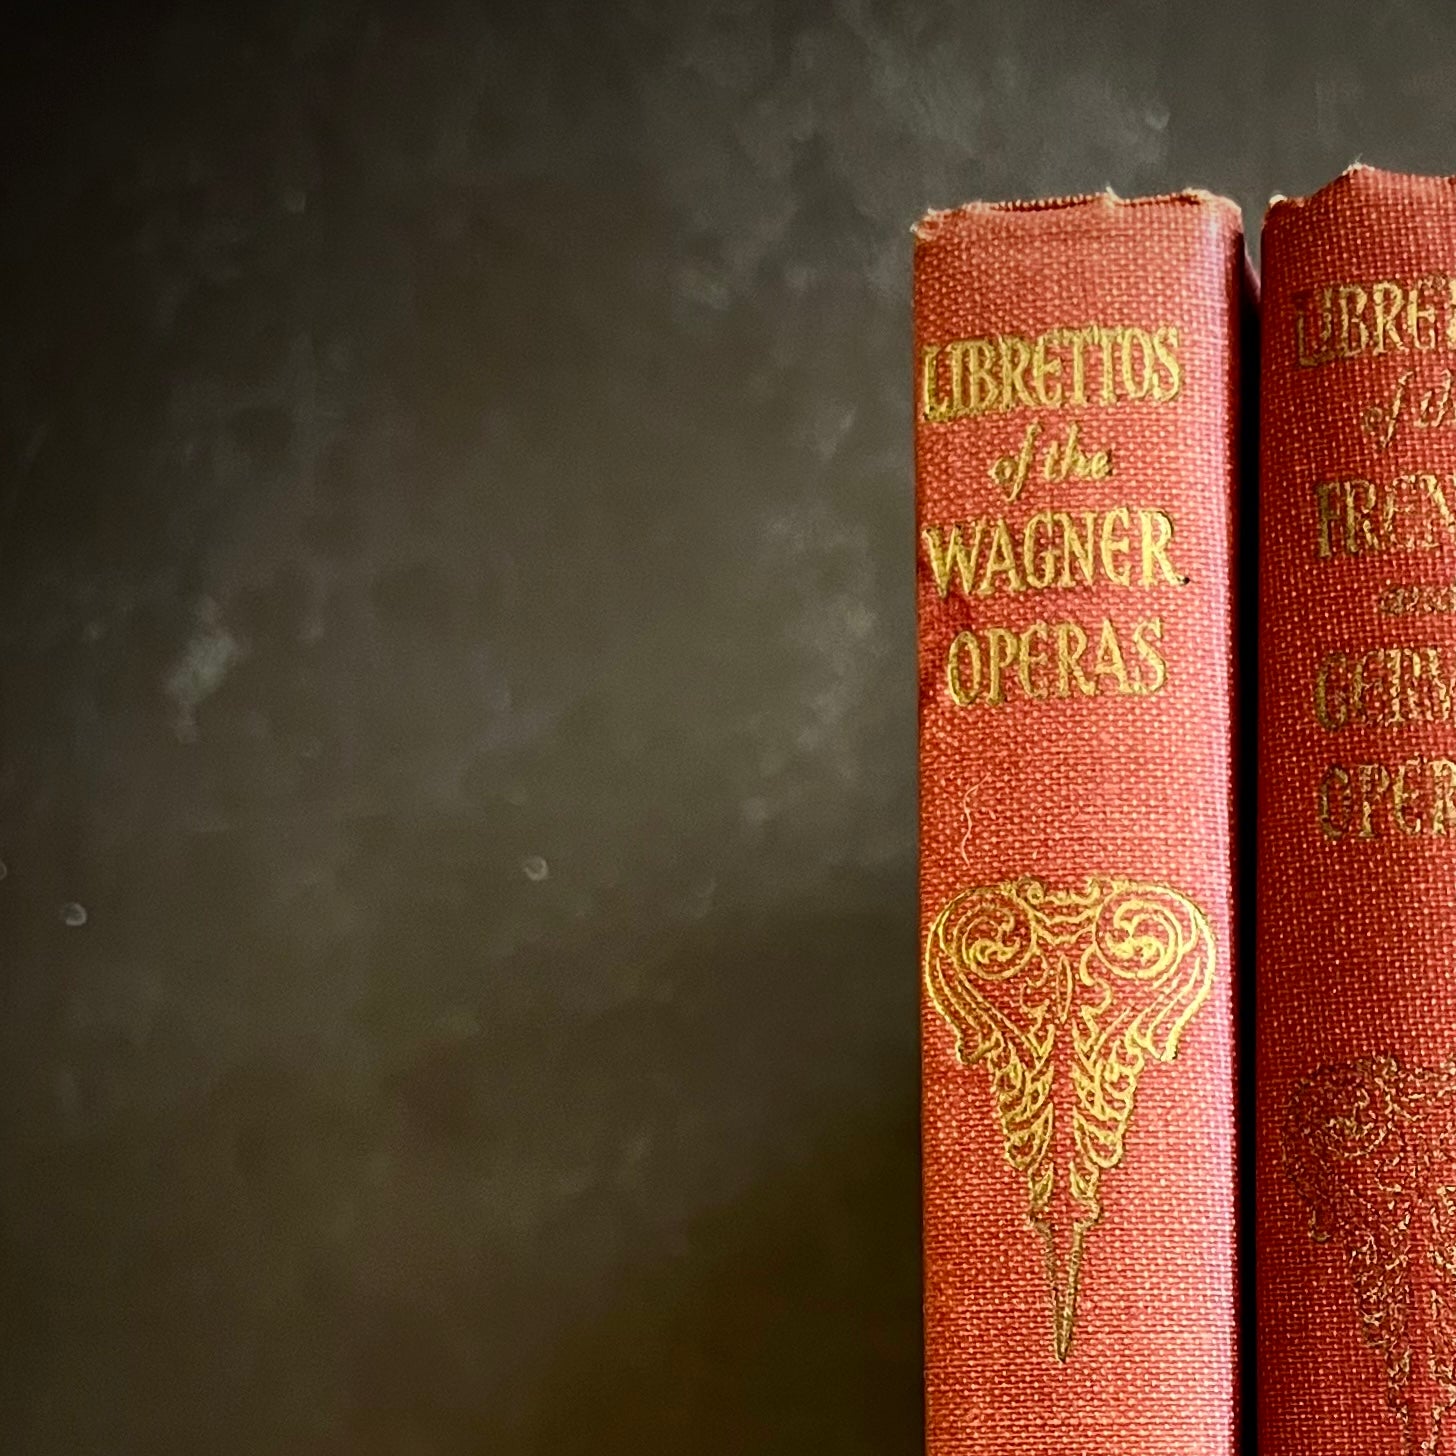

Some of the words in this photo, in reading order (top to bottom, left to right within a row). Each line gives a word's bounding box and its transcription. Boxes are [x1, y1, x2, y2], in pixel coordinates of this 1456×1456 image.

[922, 324, 1184, 421] LIBRETTOS
[1364, 367, 1416, 449] of
[988, 418, 1042, 502] of
[1044, 421, 1113, 482] the
[921, 507, 1190, 598] WAGNER
[946, 618, 1167, 707] OPERAS
